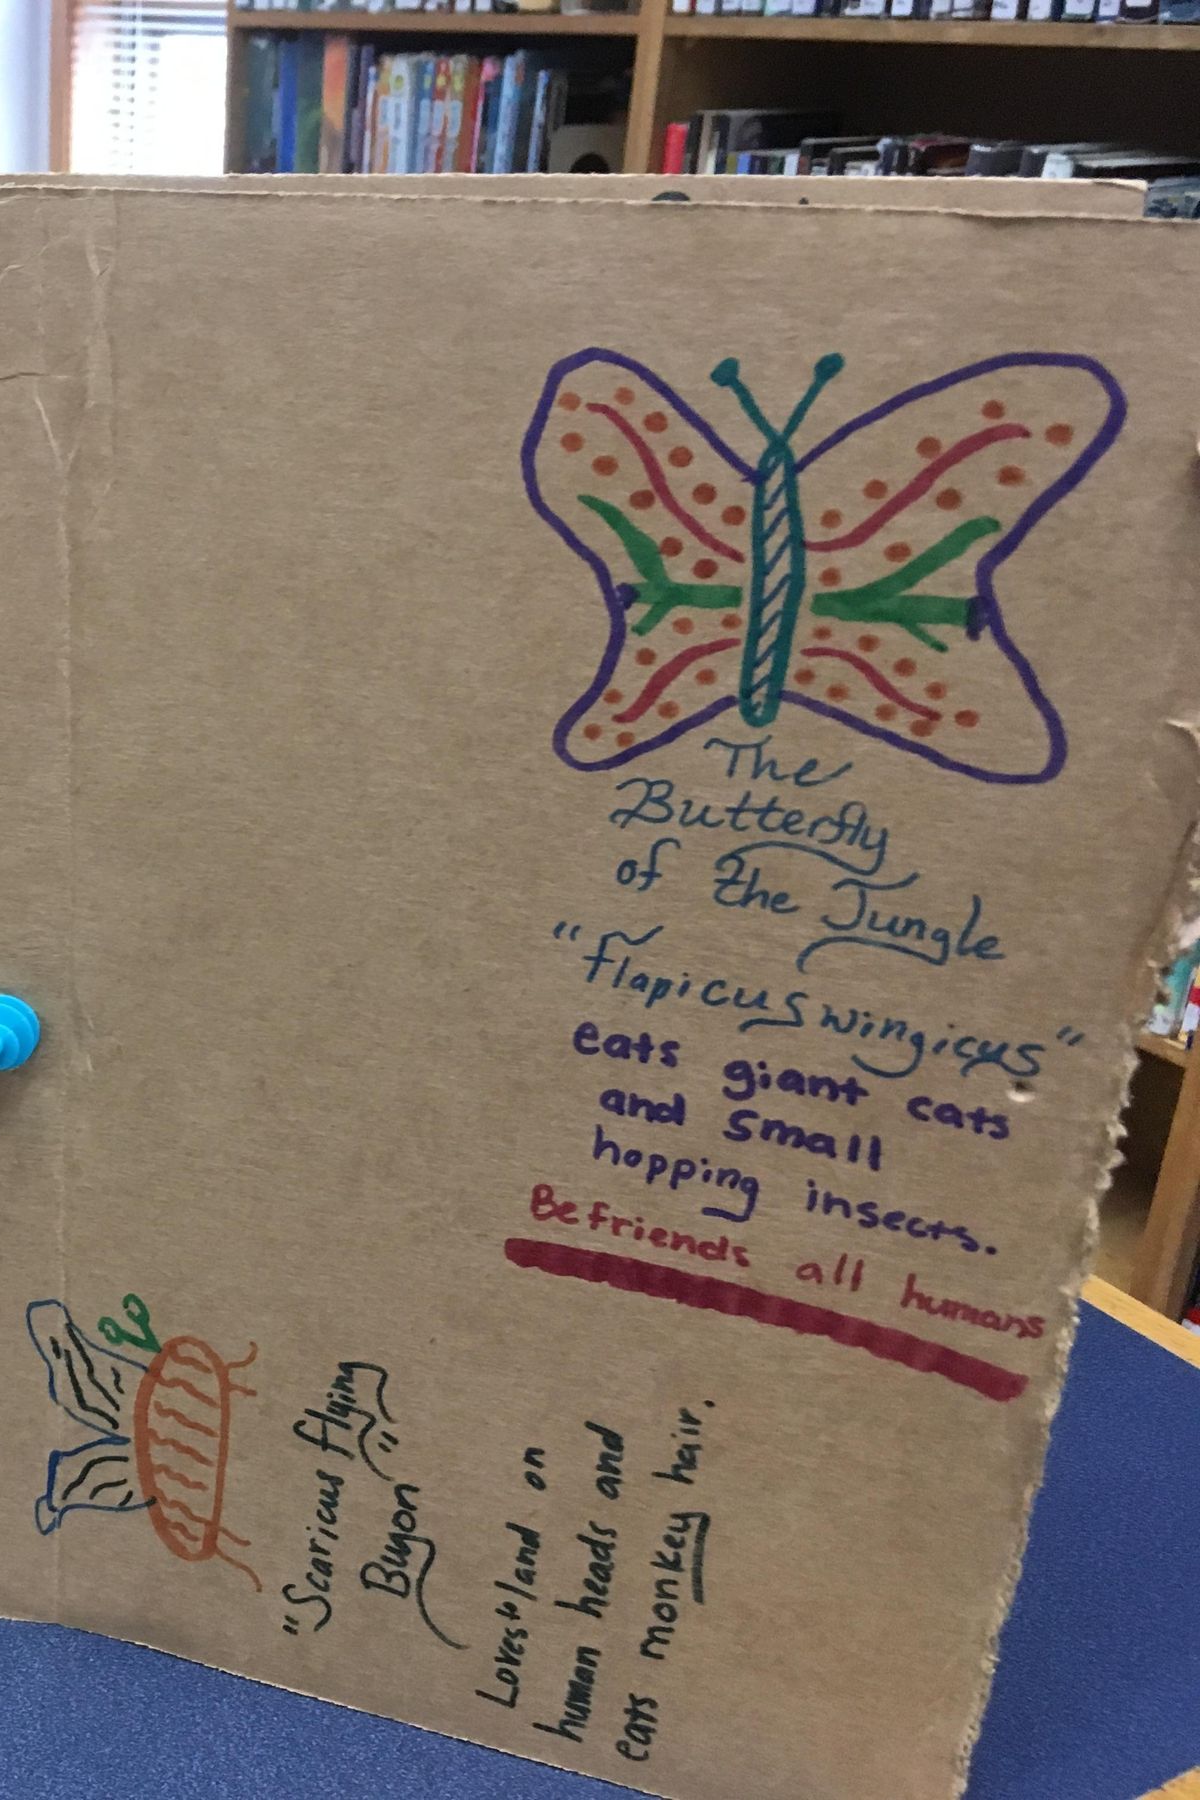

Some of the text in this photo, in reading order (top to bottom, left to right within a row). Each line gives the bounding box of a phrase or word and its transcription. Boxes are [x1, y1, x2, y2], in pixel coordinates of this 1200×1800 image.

[704, 734, 853, 787] The
[609, 778, 889, 876] Butterfly
[616, 837, 681, 891] of
[796, 872, 1005, 974] Jungle
[572, 1020, 1011, 1140] eats giant cats
[600, 1088, 686, 1126] and
[592, 1126, 997, 1256] hopping insects.
[795, 1253, 865, 1292] all
[901, 1273, 1046, 1340] humans
[522, 1446, 547, 1492] on
[493, 1520, 541, 1602] land
[532, 1419, 625, 1744] human heads and
[474, 1627, 529, 1709] Loves
[615, 1692, 659, 1762] eats
[640, 1511, 712, 1661] monkey
